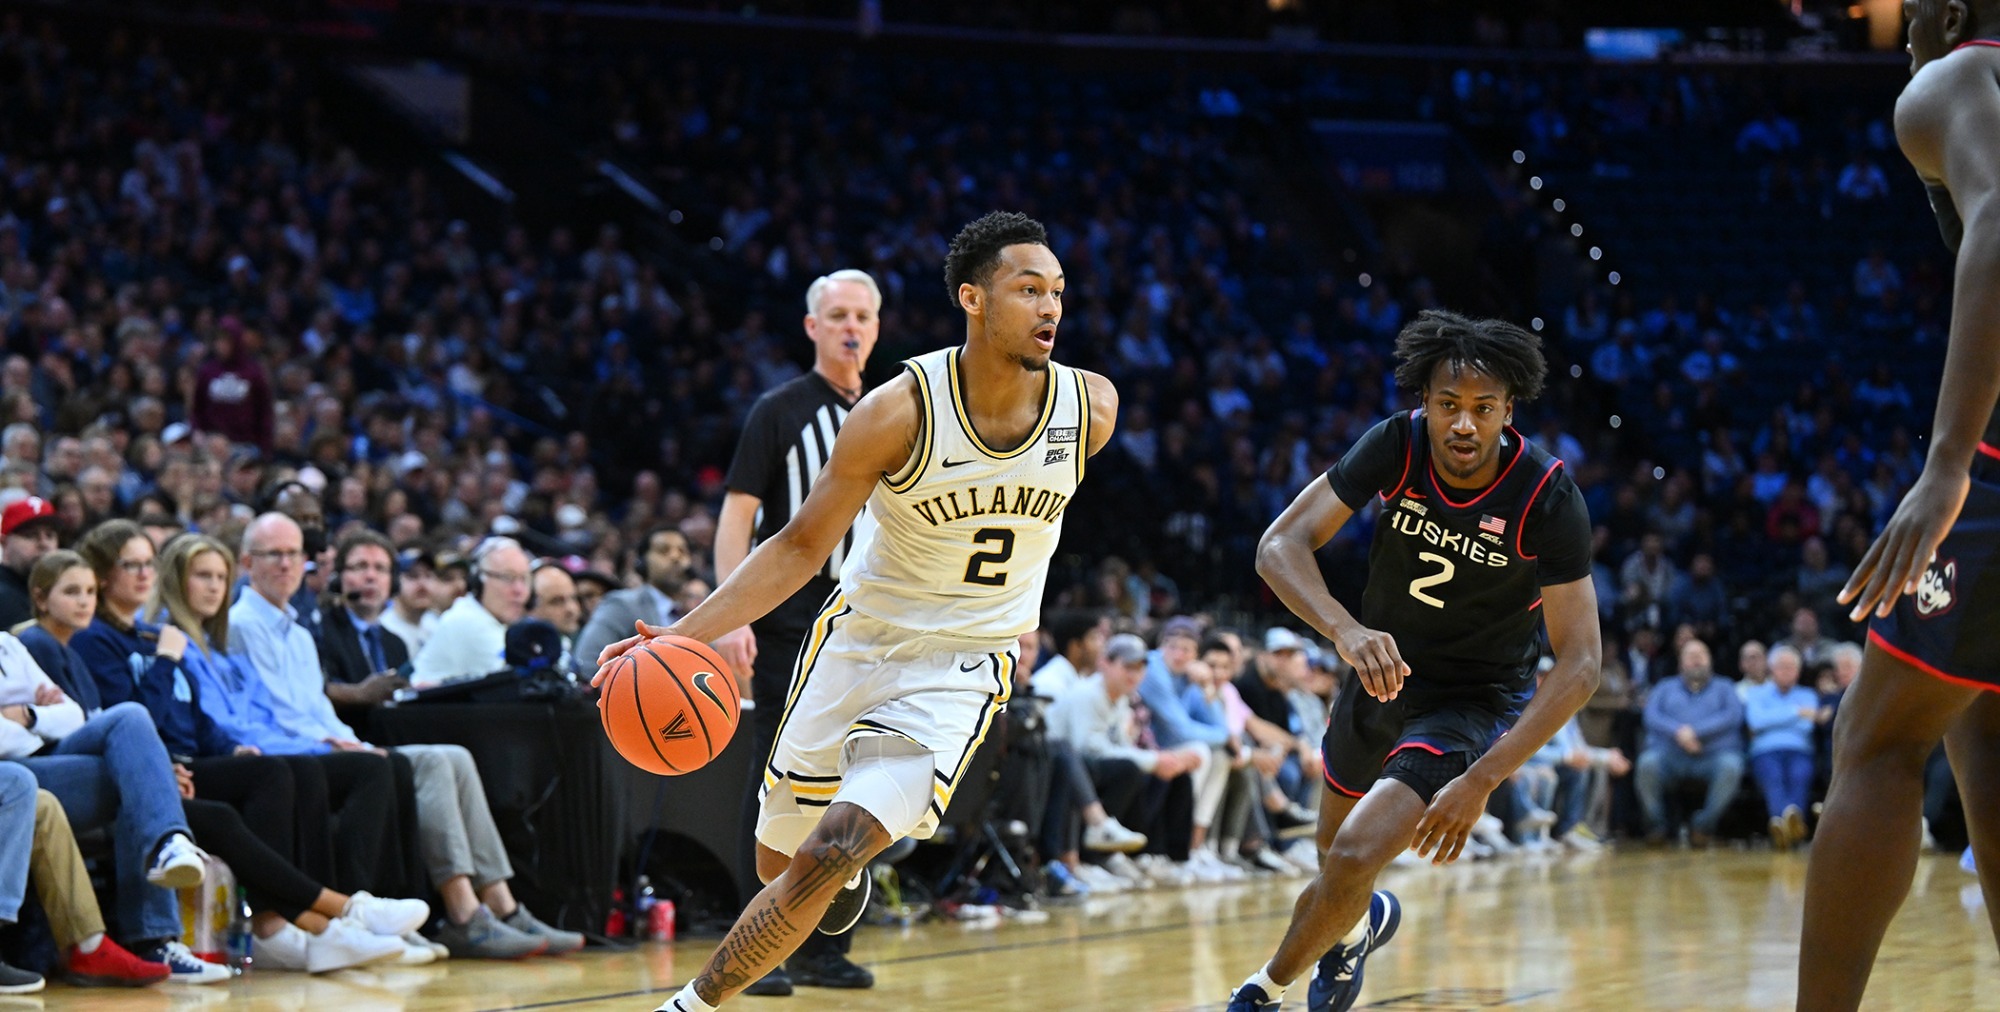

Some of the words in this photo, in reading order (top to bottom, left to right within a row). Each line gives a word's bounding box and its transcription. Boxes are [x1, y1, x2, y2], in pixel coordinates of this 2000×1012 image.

[1044, 453, 1069, 462] EAST
[1046, 448, 1066, 456] BIG
[911, 486, 1066, 526] VILLANOV
[963, 527, 1016, 587] 2
[1409, 552, 1455, 609] 2
[659, 709, 696, 743] V
